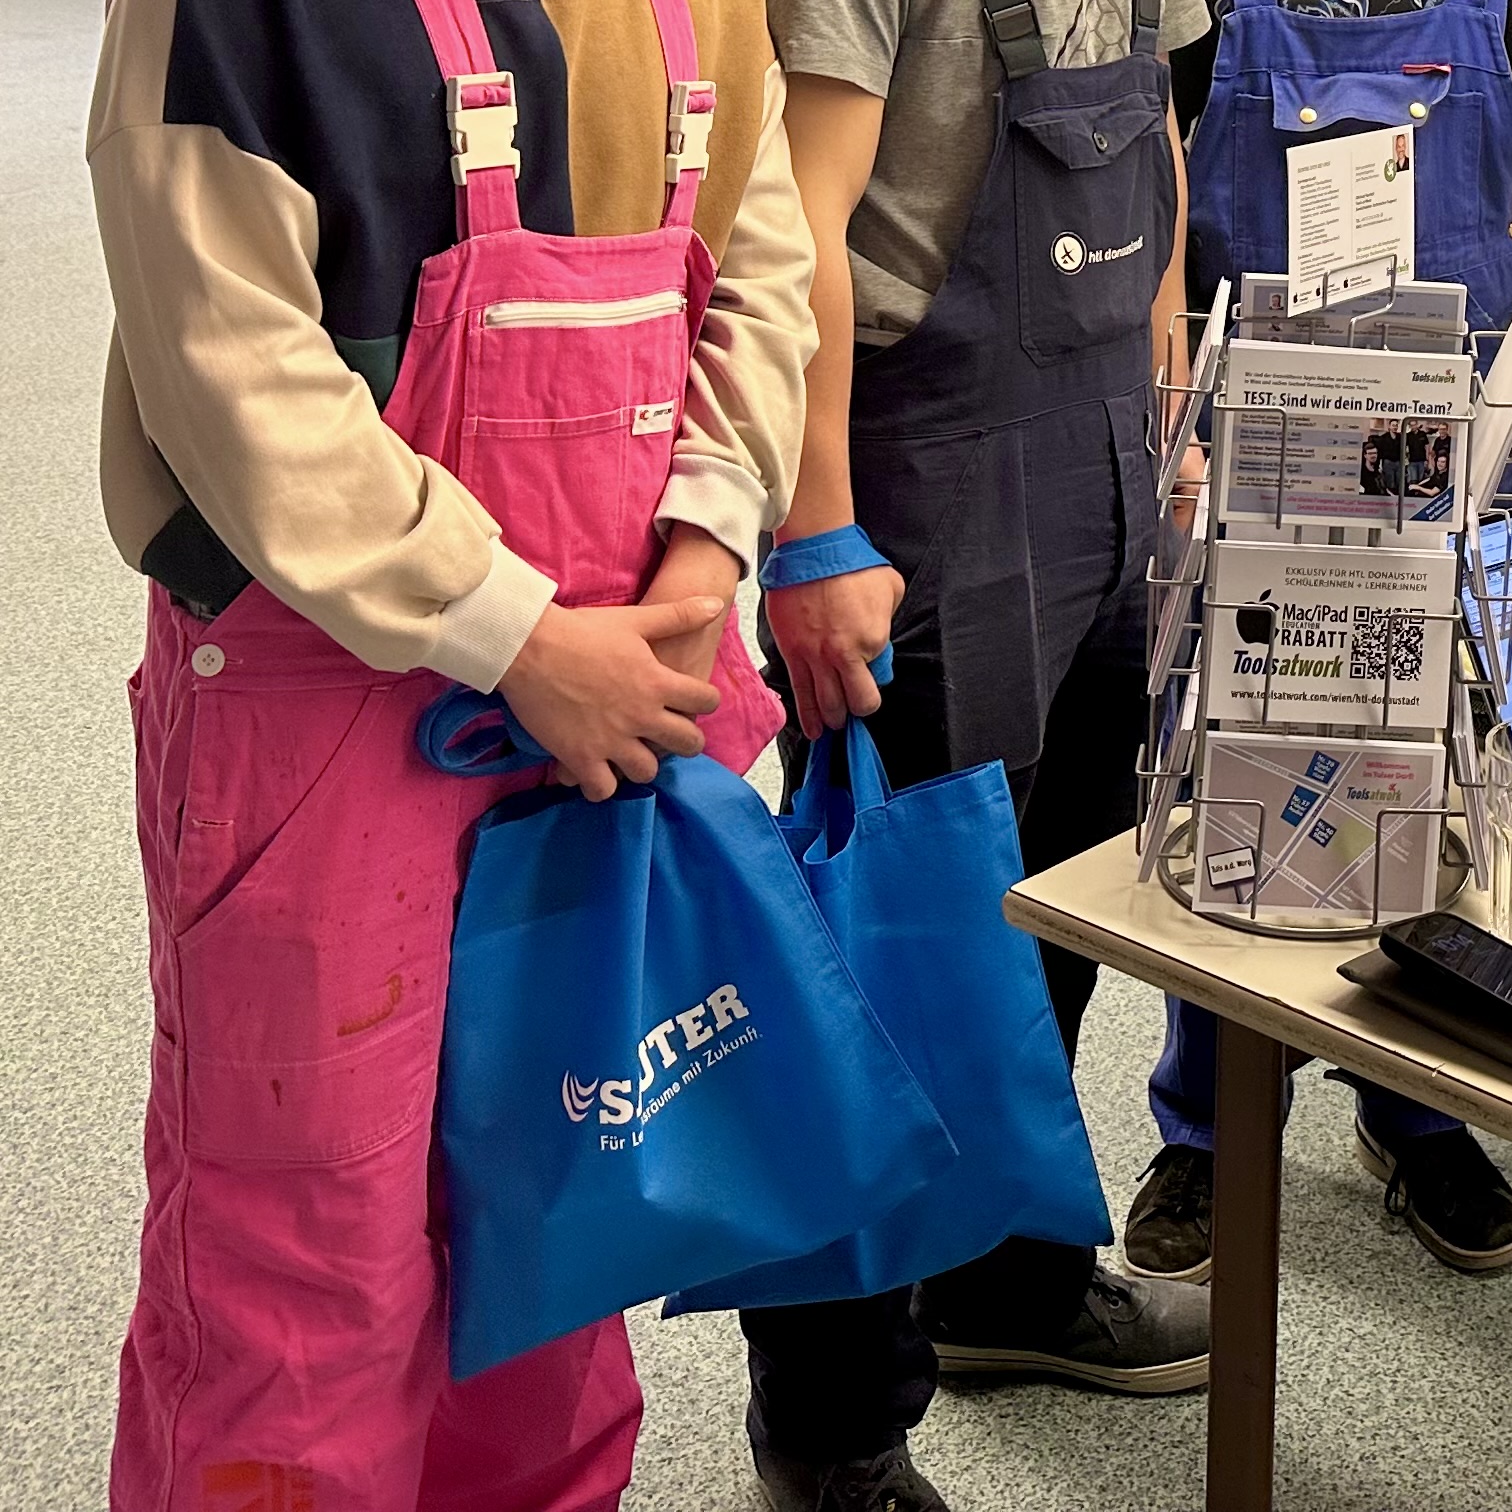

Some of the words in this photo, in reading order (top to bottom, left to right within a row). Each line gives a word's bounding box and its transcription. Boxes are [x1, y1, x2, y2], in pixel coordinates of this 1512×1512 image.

[1243, 390, 1276, 406] TEST:
[1279, 391, 1307, 408] Sind
[1310, 394, 1332, 409] wir
[1334, 395, 1362, 411] dein
[1365, 397, 1452, 416] Dream-Team?
[1285, 566, 1327, 577] EXKLUSIV
[1329, 568, 1347, 578] FÜR
[1349, 570, 1365, 579] HTL
[1368, 571, 1428, 581] DONAUSTADT
[1282, 602, 1348, 623] Mac/iPad
[1281, 628, 1347, 648] RABATT
[599, 983, 750, 1125] SUTER
[600, 1134, 626, 1151] Für
[681, 1060, 703, 1085] mit
